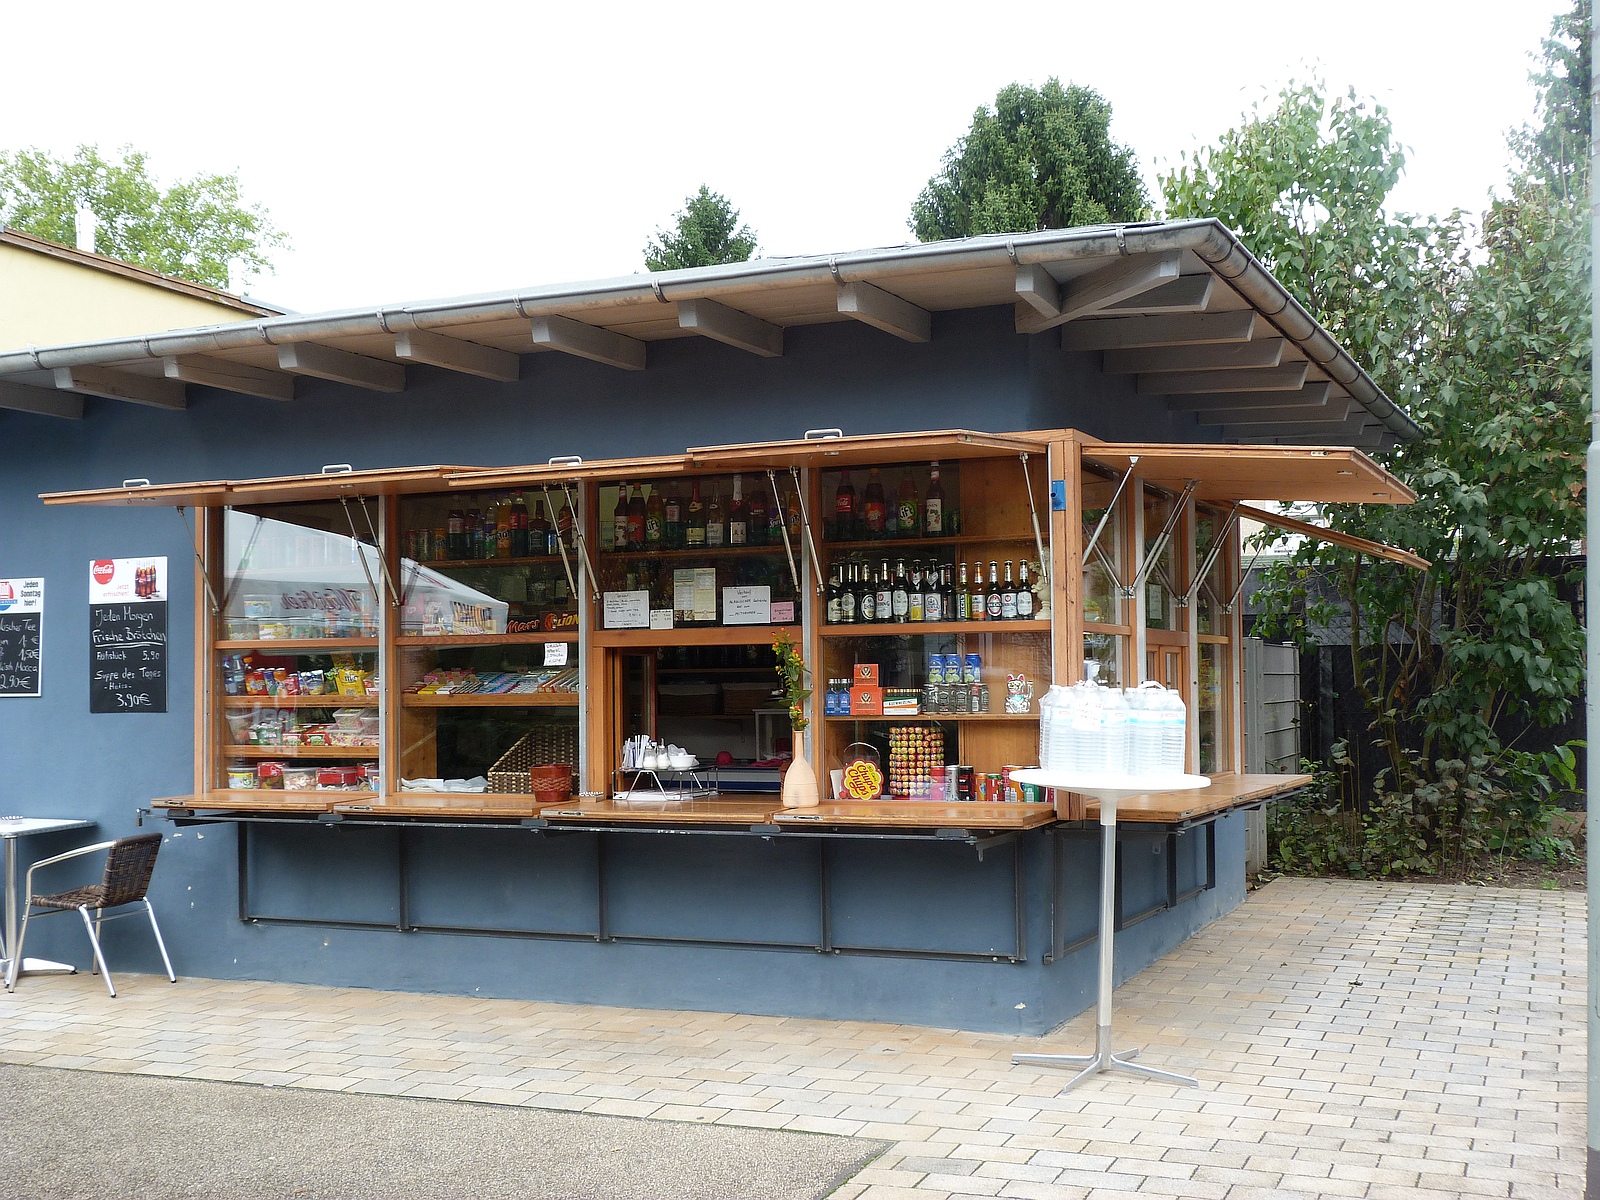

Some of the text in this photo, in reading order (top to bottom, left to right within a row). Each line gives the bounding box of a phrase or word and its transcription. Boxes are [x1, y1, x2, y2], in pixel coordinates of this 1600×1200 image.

[23, 580, 39, 589] Jeden
[20, 590, 42, 598] Sonntag
[95, 605, 154, 628] Jeden Morgen
[22, 618, 37, 631] Tee
[504, 619, 540, 634] Mars
[92, 629, 124, 643] Frische
[121, 667, 136, 680] des
[848, 769, 870, 796] Chups
[856, 764, 878, 791] Chupa
